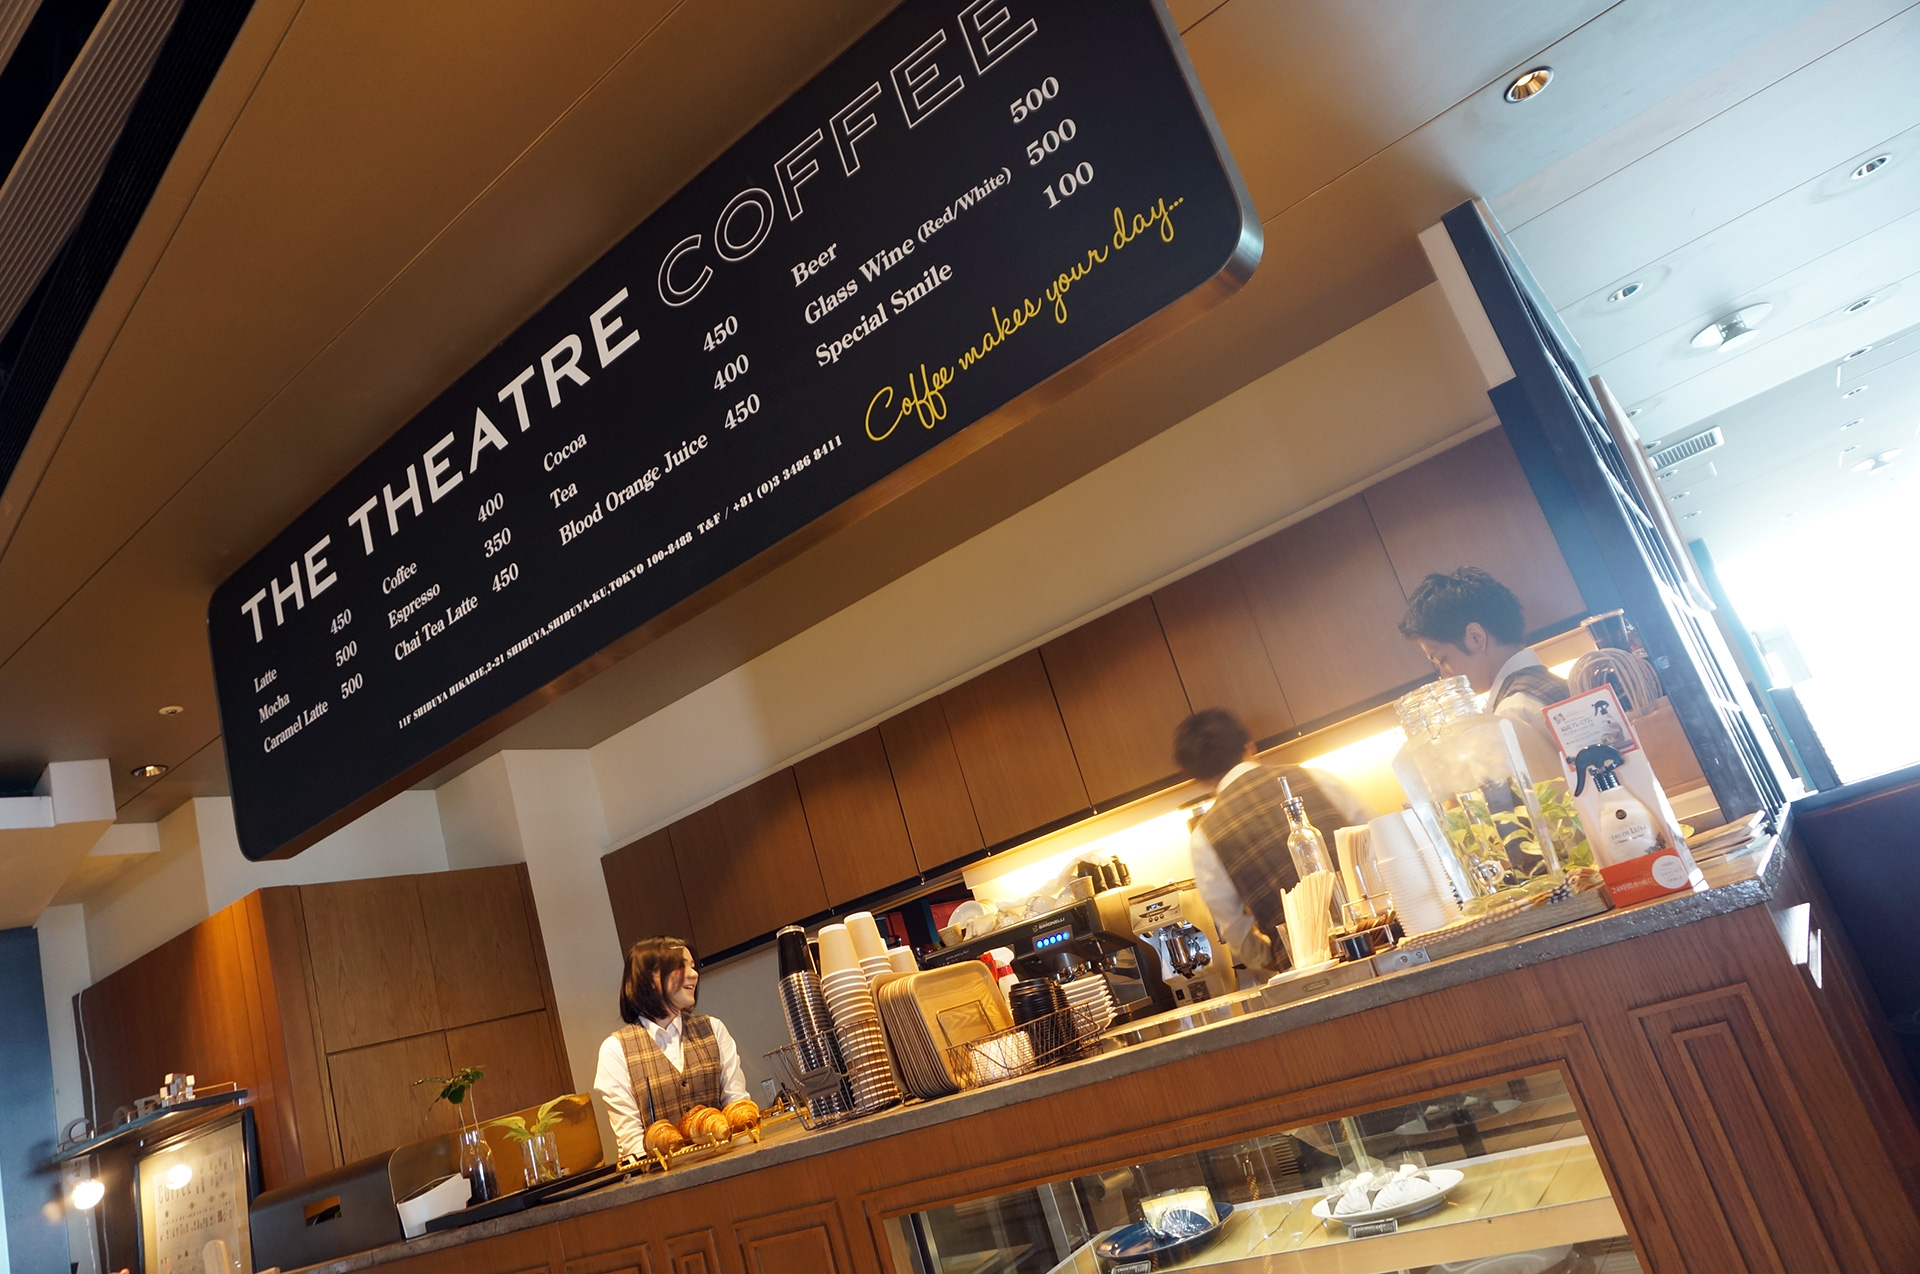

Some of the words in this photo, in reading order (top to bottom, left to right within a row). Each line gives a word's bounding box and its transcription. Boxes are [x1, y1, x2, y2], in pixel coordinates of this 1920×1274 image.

[791, 243, 836, 287] Beer
[1010, 77, 1059, 123] 500
[805, 280, 858, 324] Glass
[859, 239, 915, 282] Wine
[918, 168, 1011, 242] (Red/White)
[1027, 119, 1076, 165] 500
[242, 535, 337, 642] THE
[348, 287, 640, 555] THEATRE
[658, 0, 1038, 306] COFFEE
[816, 303, 888, 366] Special
[891, 265, 952, 314] Smile
[1043, 162, 1093, 208] 100
[544, 434, 587, 471] Cocoa
[704, 316, 737, 351] 450
[864, 363, 955, 442] Coffee
[958, 296, 1042, 370] makes
[1046, 245, 1108, 324] your
[550, 483, 578, 508] Tea
[714, 355, 748, 390] 400
[559, 502, 603, 545] Blood
[606, 467, 661, 511] Orange
[664, 435, 708, 473] Juice
[725, 394, 760, 429] 450
[383, 563, 417, 594] Coffee
[478, 493, 503, 522] 400
[388, 584, 440, 628] Espresso
[485, 528, 511, 557] 350
[395, 631, 421, 660] Chai
[422, 620, 445, 641] Tea
[446, 597, 478, 625] Latte
[493, 563, 518, 592] 450
[398, 714, 412, 729] 11F
[413, 692, 448, 719] SHIBUYA
[697, 513, 720, 534] T&F
[734, 493, 753, 511] +81
[757, 475, 780, 498] (0)3
[783, 455, 811, 480] 3486
[813, 435, 841, 460] 8411
[254, 670, 276, 692] Latte
[331, 609, 351, 634] 450
[259, 694, 290, 723] Mocha
[336, 641, 357, 666] 500
[264, 715, 302, 752] Caramel
[303, 702, 328, 725] Latte
[341, 673, 362, 699] 500
